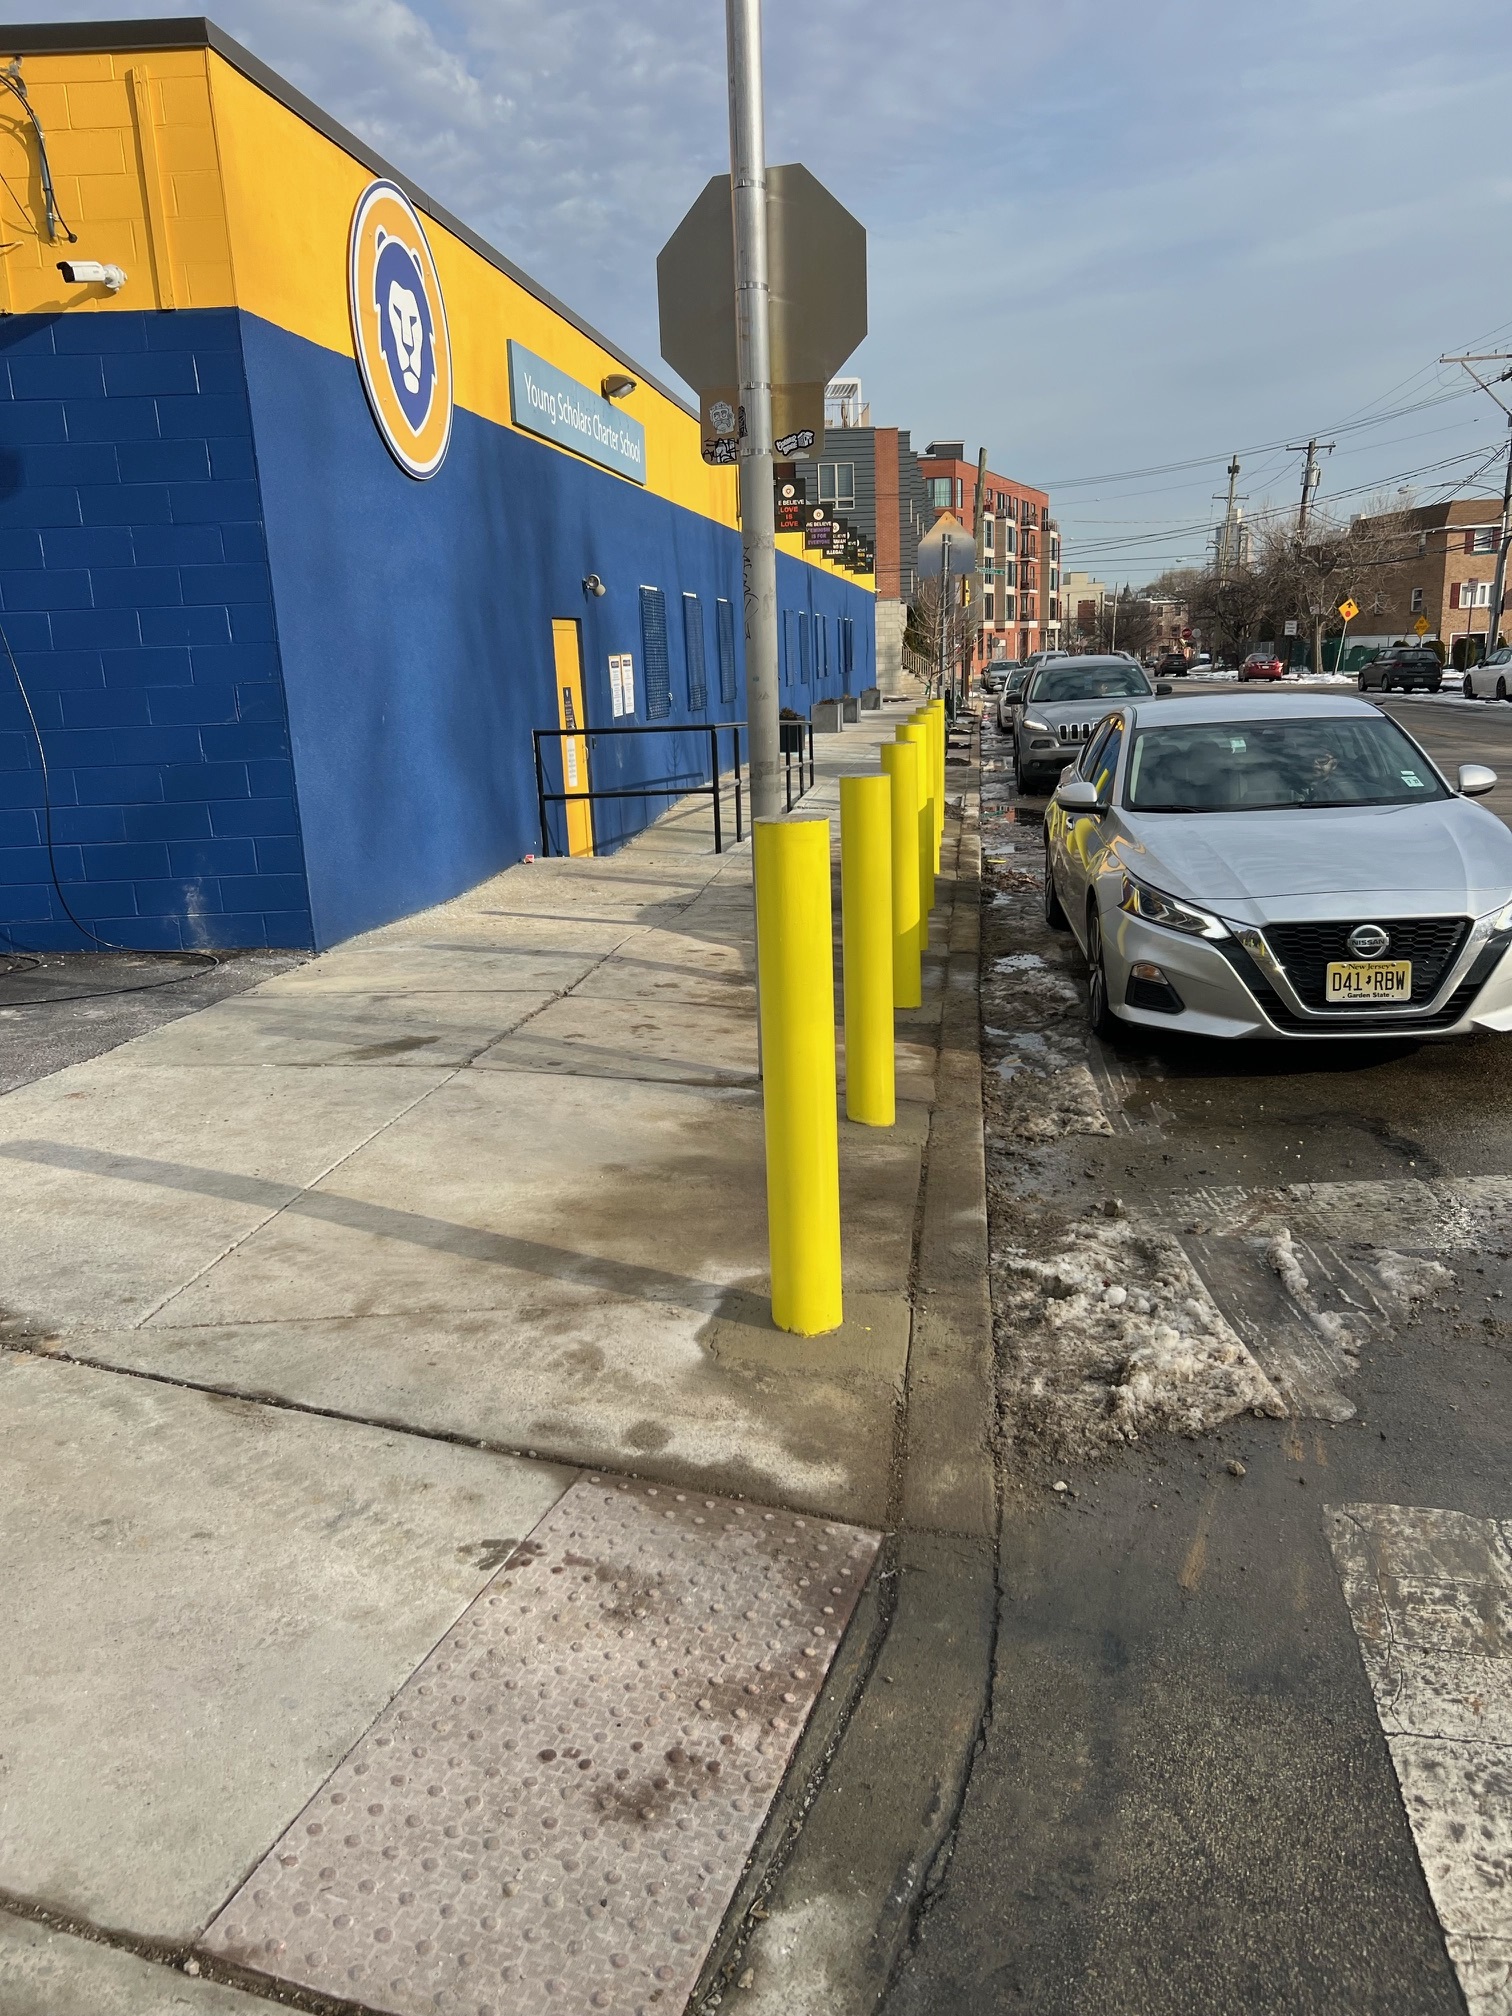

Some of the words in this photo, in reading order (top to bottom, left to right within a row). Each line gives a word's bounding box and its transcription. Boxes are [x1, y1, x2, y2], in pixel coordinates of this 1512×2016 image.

[524, 372, 556, 425] Young
[557, 392, 592, 436] Scholars
[592, 414, 619, 451] Charter
[620, 430, 641, 463] School
[1348, 963, 1366, 971] New
[1367, 962, 1391, 971] Jersey
[1332, 972, 1363, 992] D41
[1374, 970, 1405, 991] RBW
